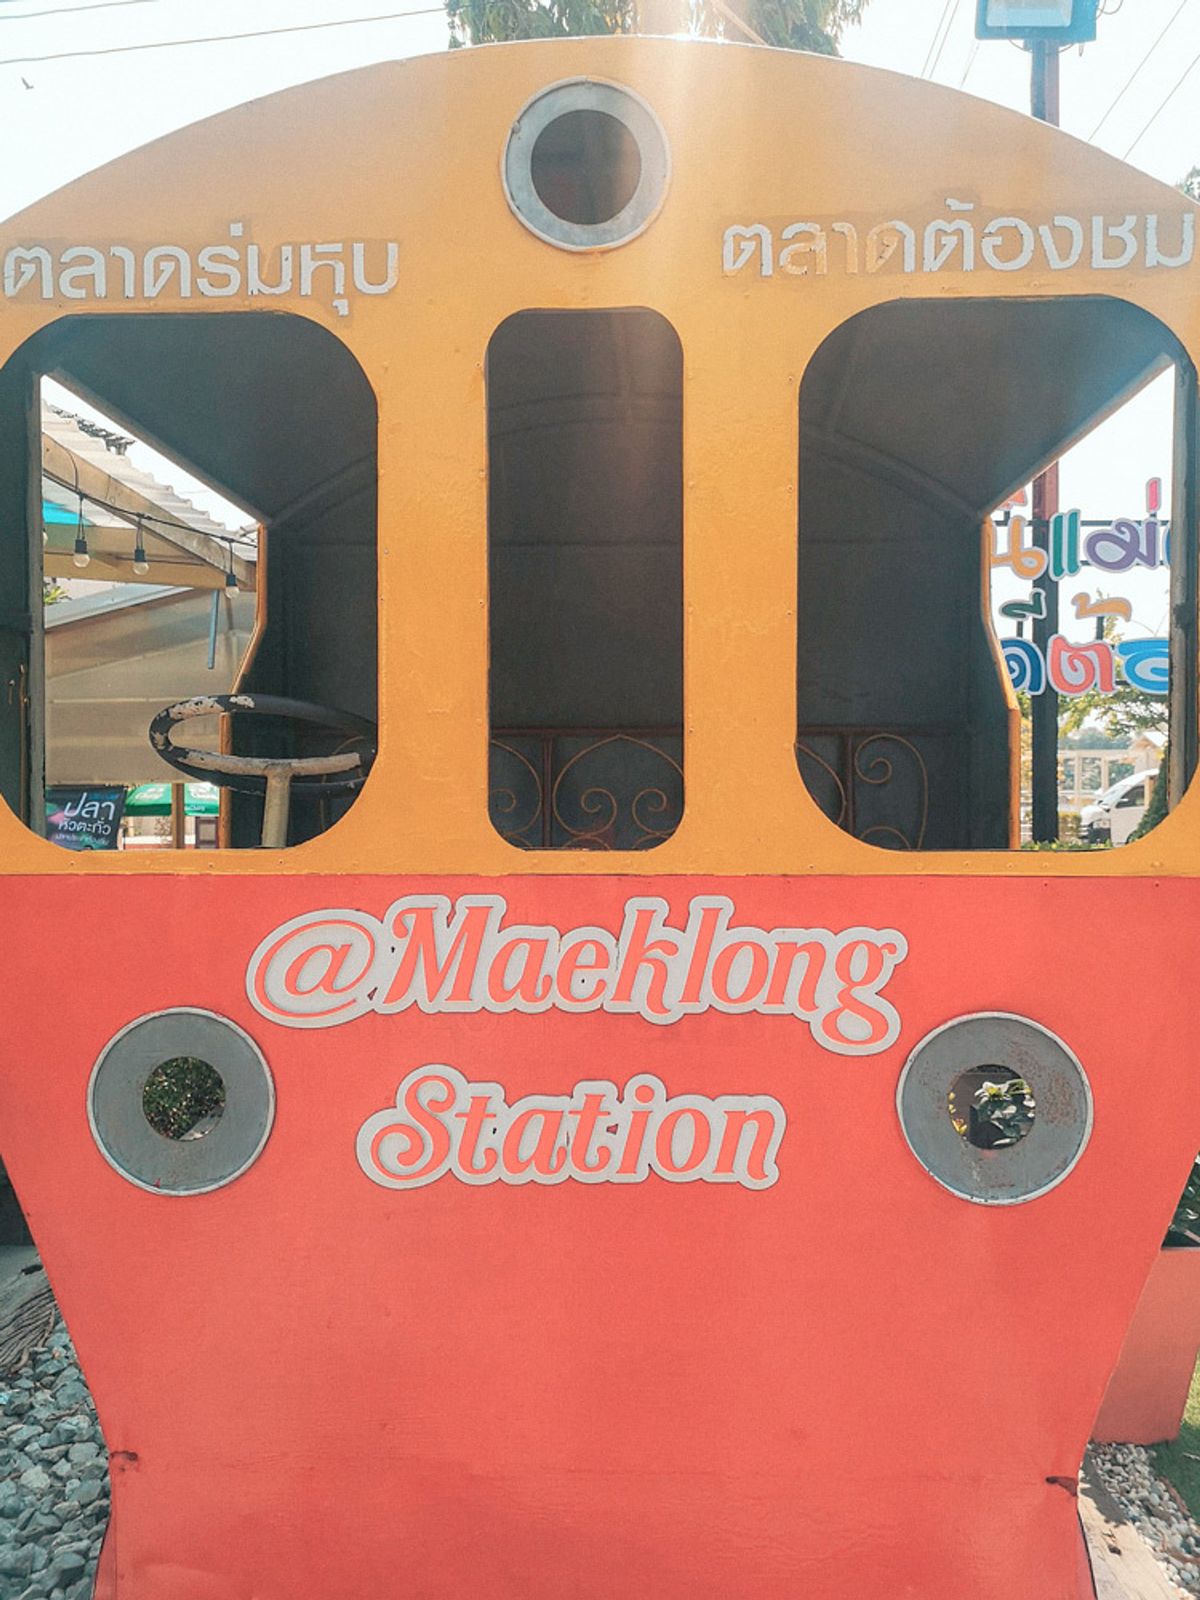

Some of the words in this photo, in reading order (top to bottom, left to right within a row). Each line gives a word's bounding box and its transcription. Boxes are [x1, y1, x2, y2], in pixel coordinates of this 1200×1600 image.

[3, 222, 399, 316] ตลาดร่มหุบ
[722, 198, 1195, 277] ตลาดต้องชม
[64, 792, 115, 820] ปลา
[249, 899, 902, 1050] @Maeklong
[368, 1070, 778, 1184] Station
